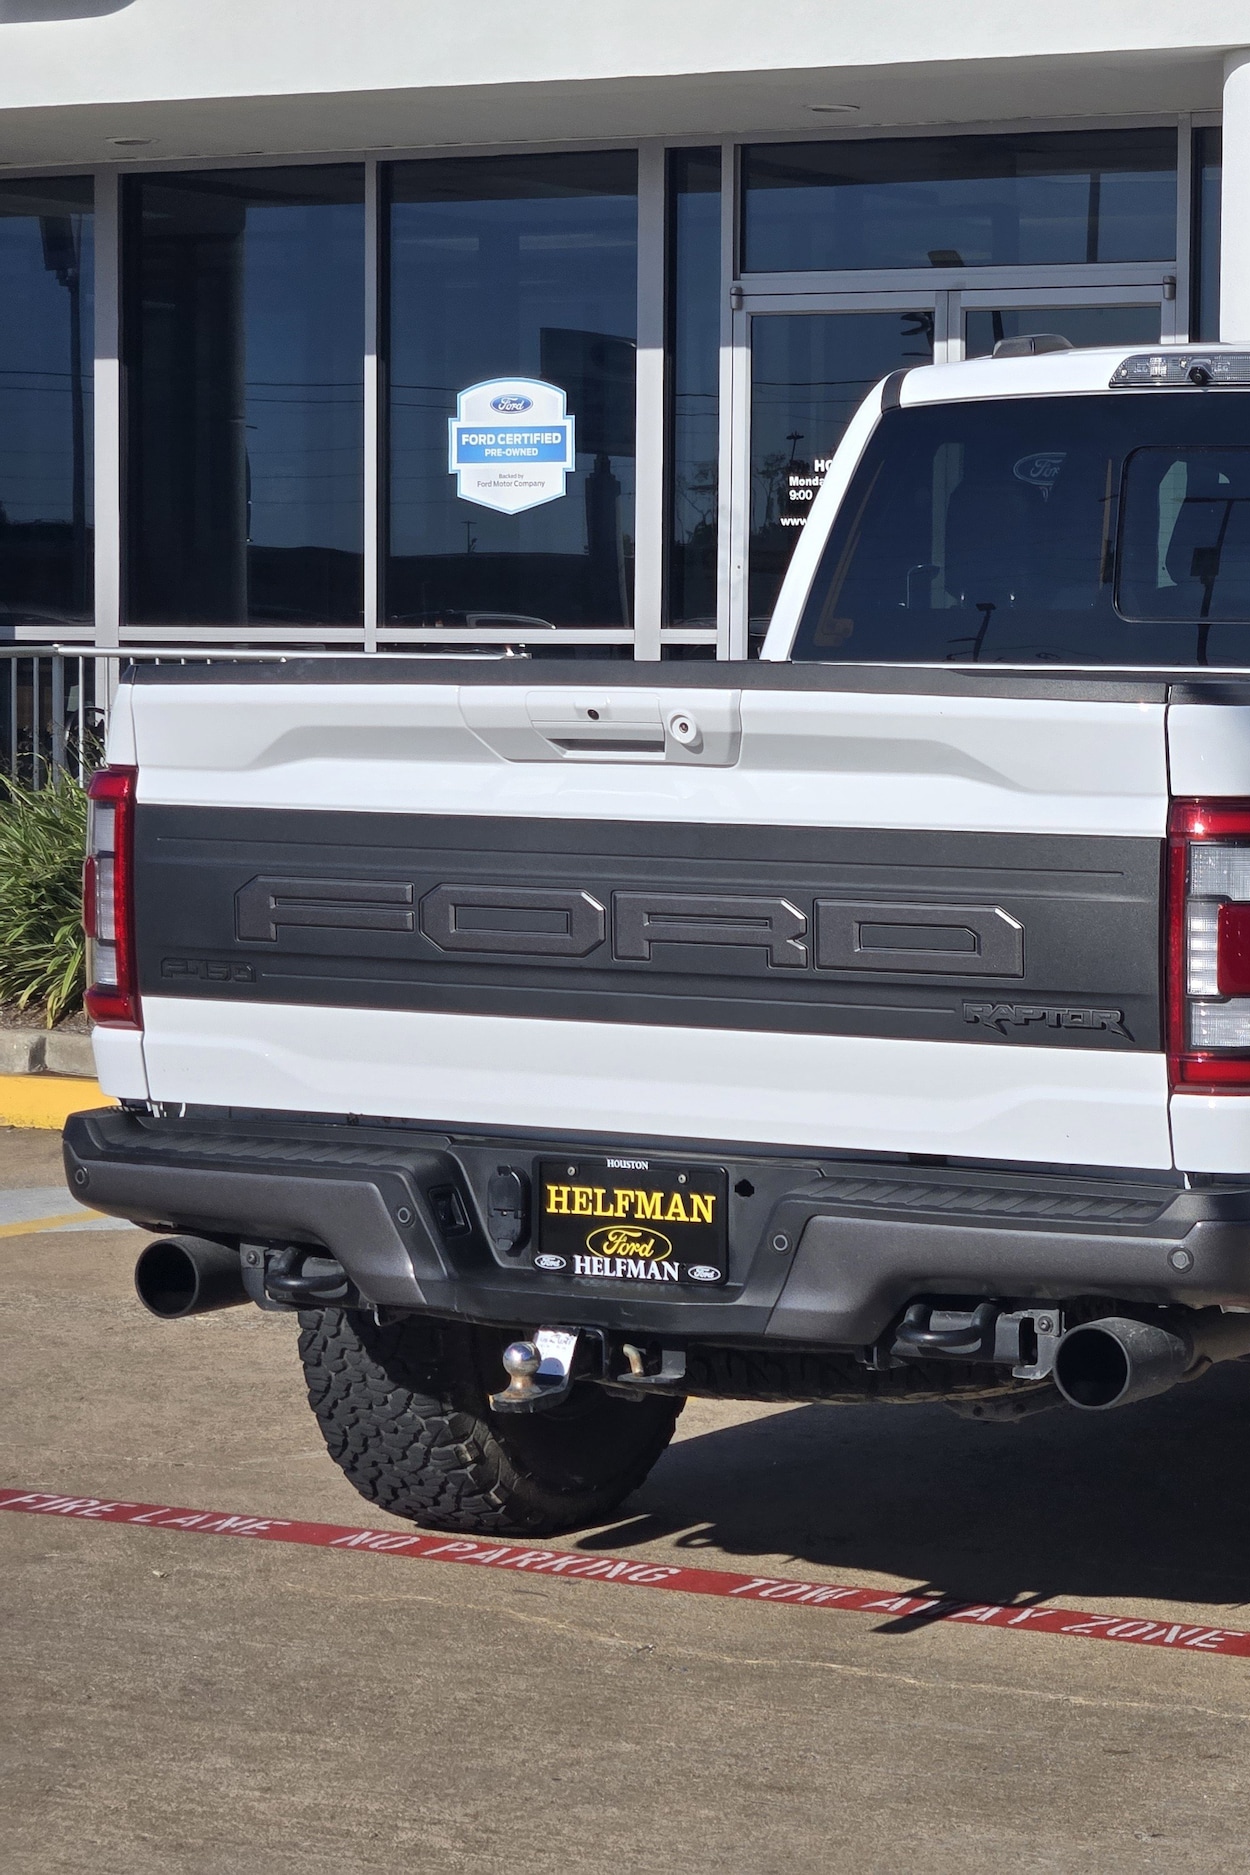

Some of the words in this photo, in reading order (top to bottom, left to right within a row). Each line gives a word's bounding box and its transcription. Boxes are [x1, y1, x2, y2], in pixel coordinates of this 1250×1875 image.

[498, 397, 524, 411] Ford
[461, 433, 495, 446] FORD
[497, 432, 562, 445] CERTIFIED
[484, 447, 539, 457] PRE-OWNED
[477, 480, 492, 488] Ford
[493, 480, 513, 488] Motor
[514, 480, 545, 489] Company
[789, 489, 813, 501] 9:00
[234, 874, 1025, 980] FORD
[963, 1000, 1136, 1043] RAPTOR
[606, 1157, 649, 1171] HOUSTON
[545, 1184, 717, 1224] HELFMAN
[602, 1228, 656, 1258] Ford
[573, 1254, 680, 1282] HELFMAN
[2, 1493, 138, 1517] FIRE
[128, 1508, 292, 1535] LANE
[329, 1530, 421, 1550] NO
[421, 1541, 682, 1583] PARKING
[729, 1578, 859, 1603] TOW
[1061, 1615, 1247, 1649] ZONE
